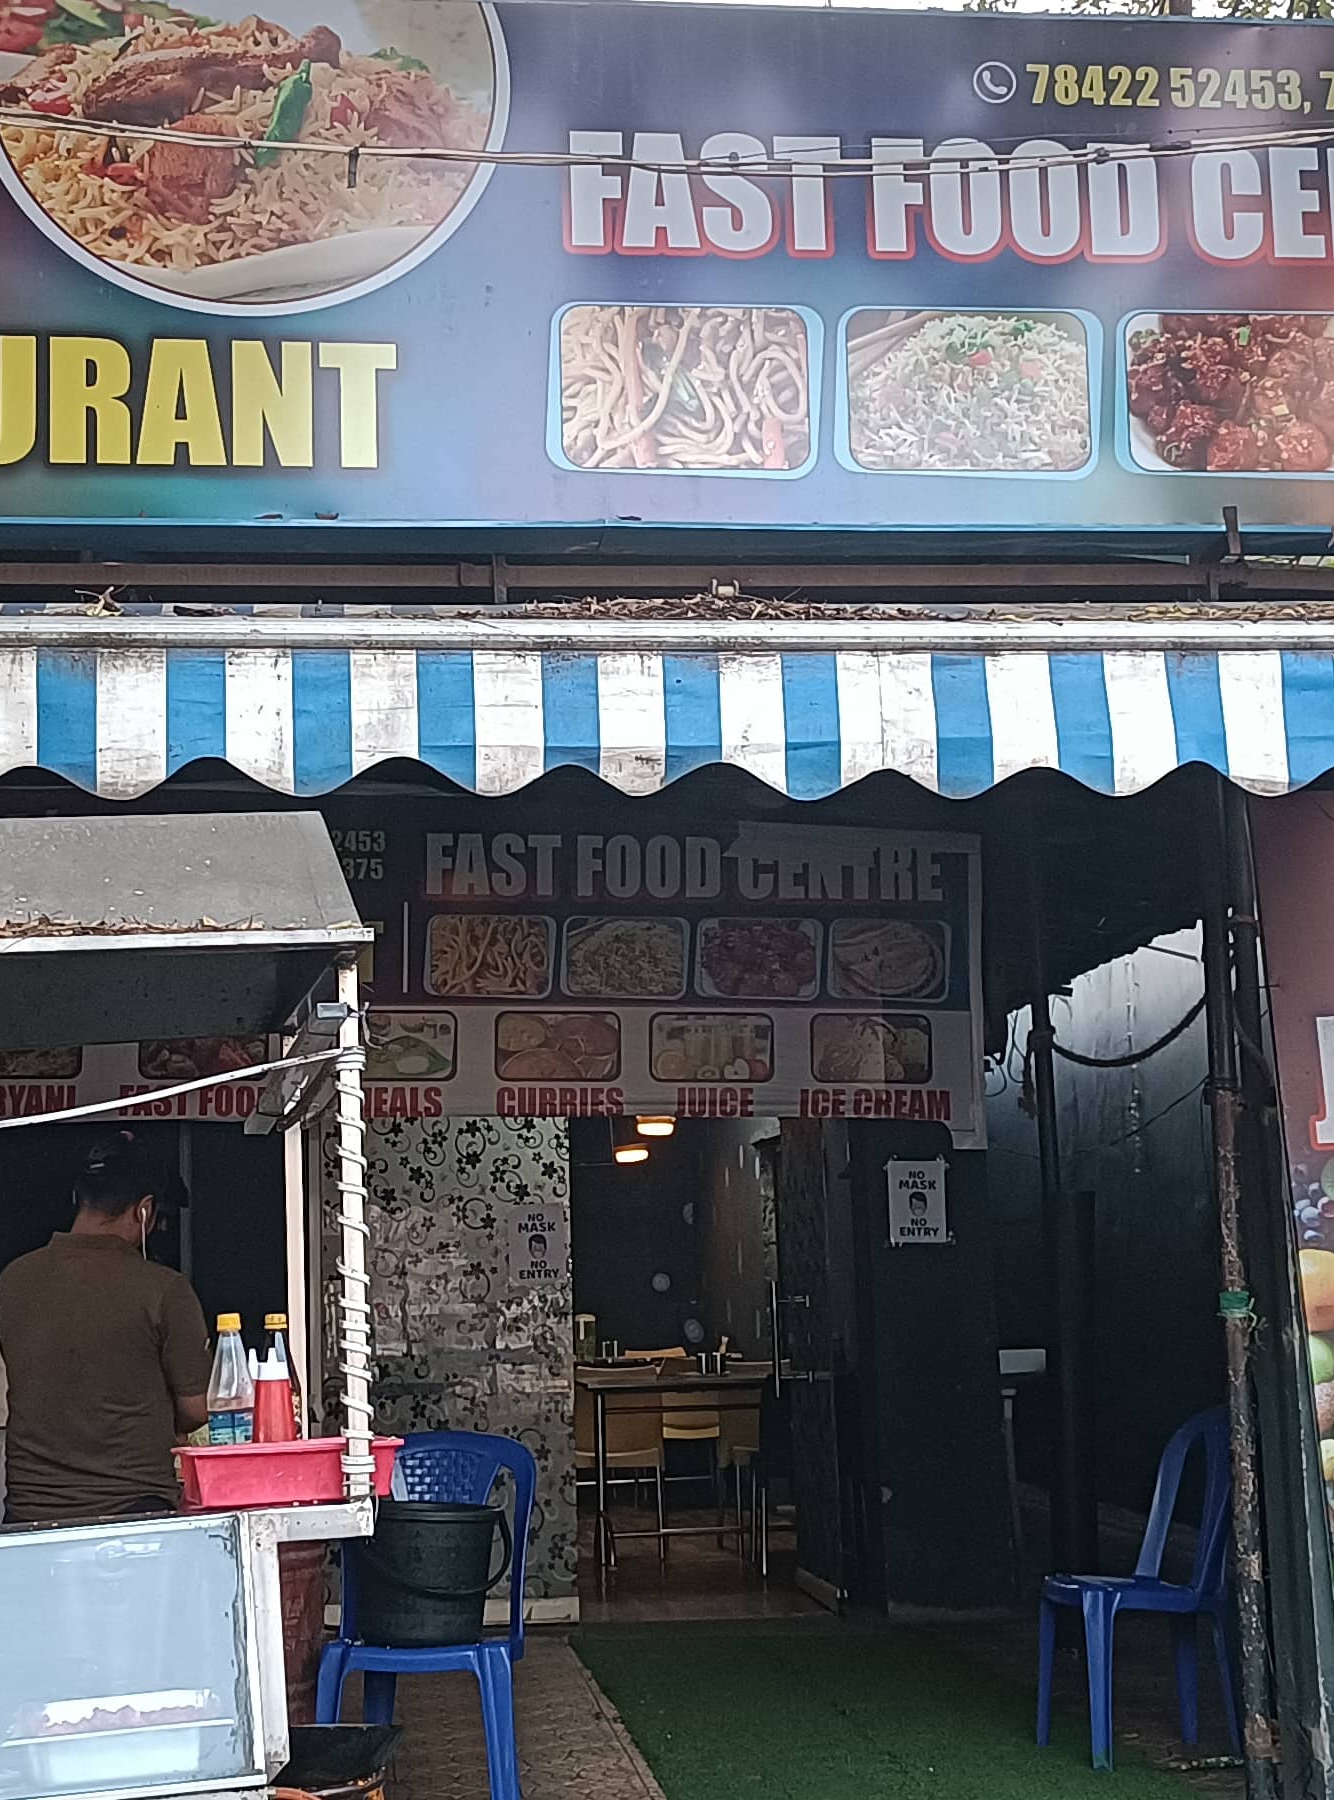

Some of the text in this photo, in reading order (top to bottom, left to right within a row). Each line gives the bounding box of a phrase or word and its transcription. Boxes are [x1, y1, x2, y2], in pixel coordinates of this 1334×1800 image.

[1027, 63, 1160, 107] 78422
[1170, 67, 1311, 114] 52453,
[564, 129, 840, 254] FAST
[873, 138, 1164, 259] FOOD
[341, 857, 384, 880] 375
[426, 832, 943, 900] FAST FOOD CENTRE
[119, 1085, 187, 1117] FAST
[496, 1086, 625, 1118] CURRIES
[676, 1087, 754, 1118] JUICE
[799, 1088, 951, 1121] ICE CREAM
[909, 1170, 925, 1179] NO
[899, 1180, 937, 1190] MASK
[528, 1213, 544, 1222] NO
[911, 1218, 927, 1226] NO
[518, 1222, 555, 1233] MASK
[900, 1227, 939, 1237] ENTRY
[531, 1260, 547, 1269] NO
[519, 1269, 560, 1279] ENTRY
